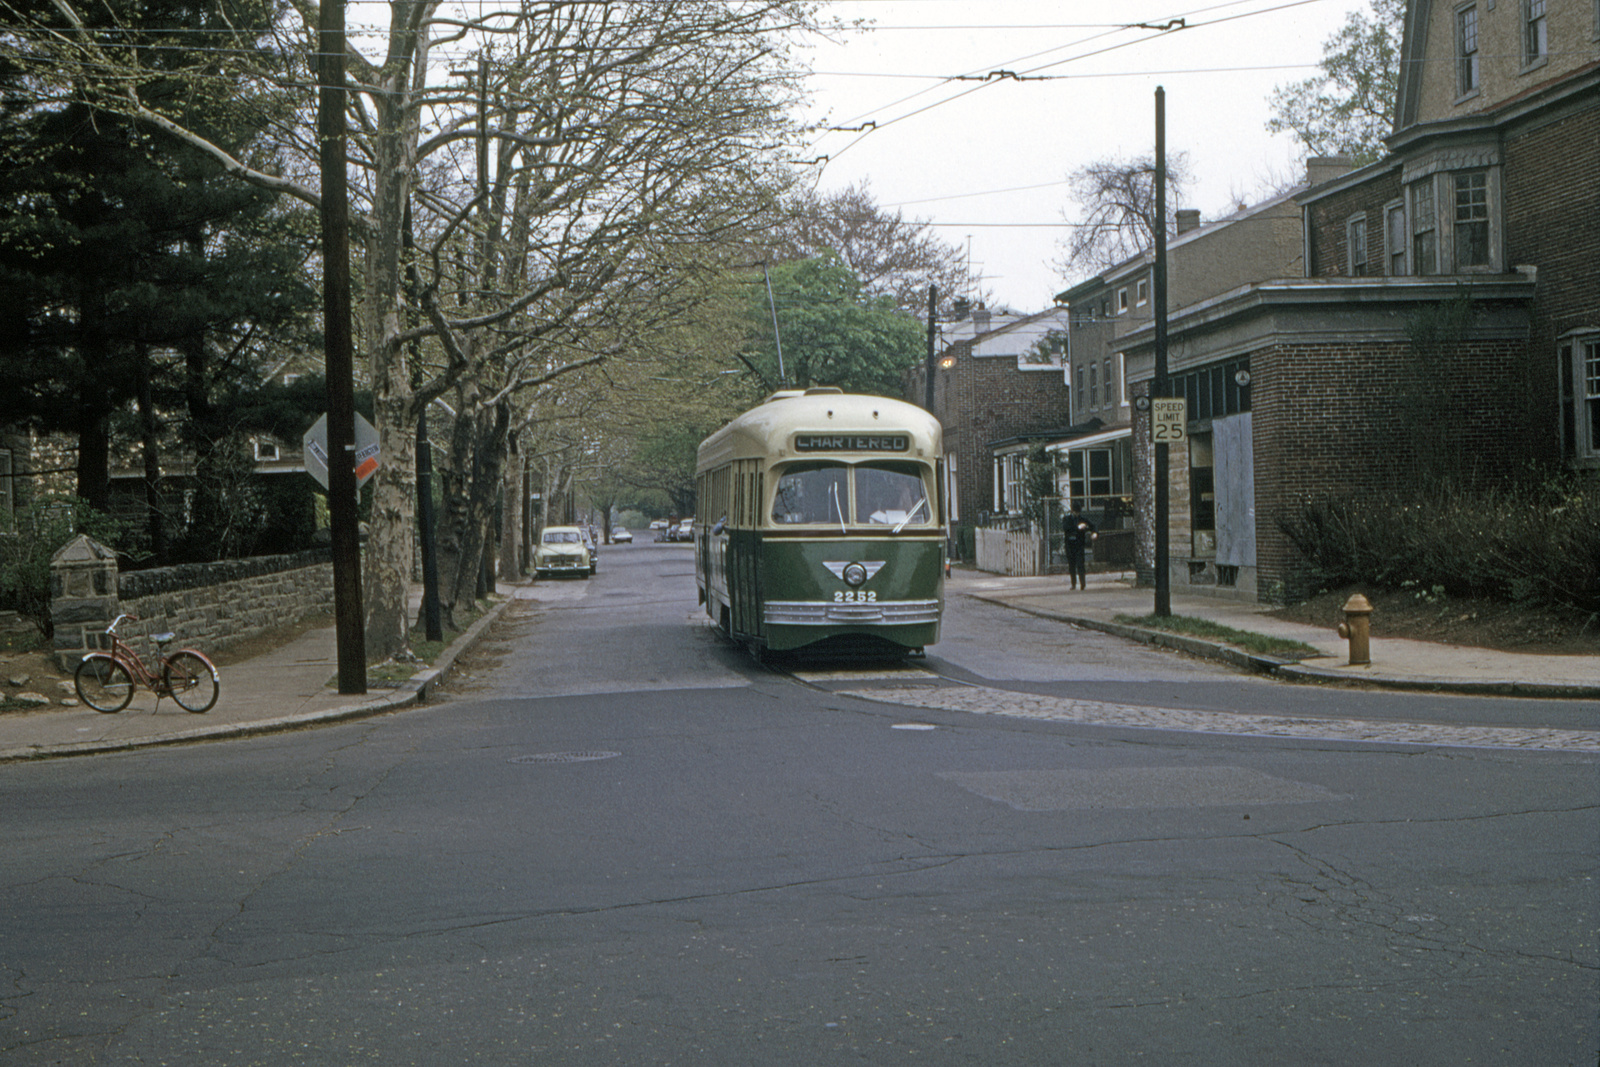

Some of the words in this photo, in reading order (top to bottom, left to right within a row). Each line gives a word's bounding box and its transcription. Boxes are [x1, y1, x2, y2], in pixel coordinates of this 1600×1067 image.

[1154, 402, 1184, 411] SPEED
[1157, 413, 1180, 422] LIMIT
[1155, 423, 1183, 439] 25
[797, 436, 905, 449] CHARTERED
[833, 590, 877, 602] 2252
